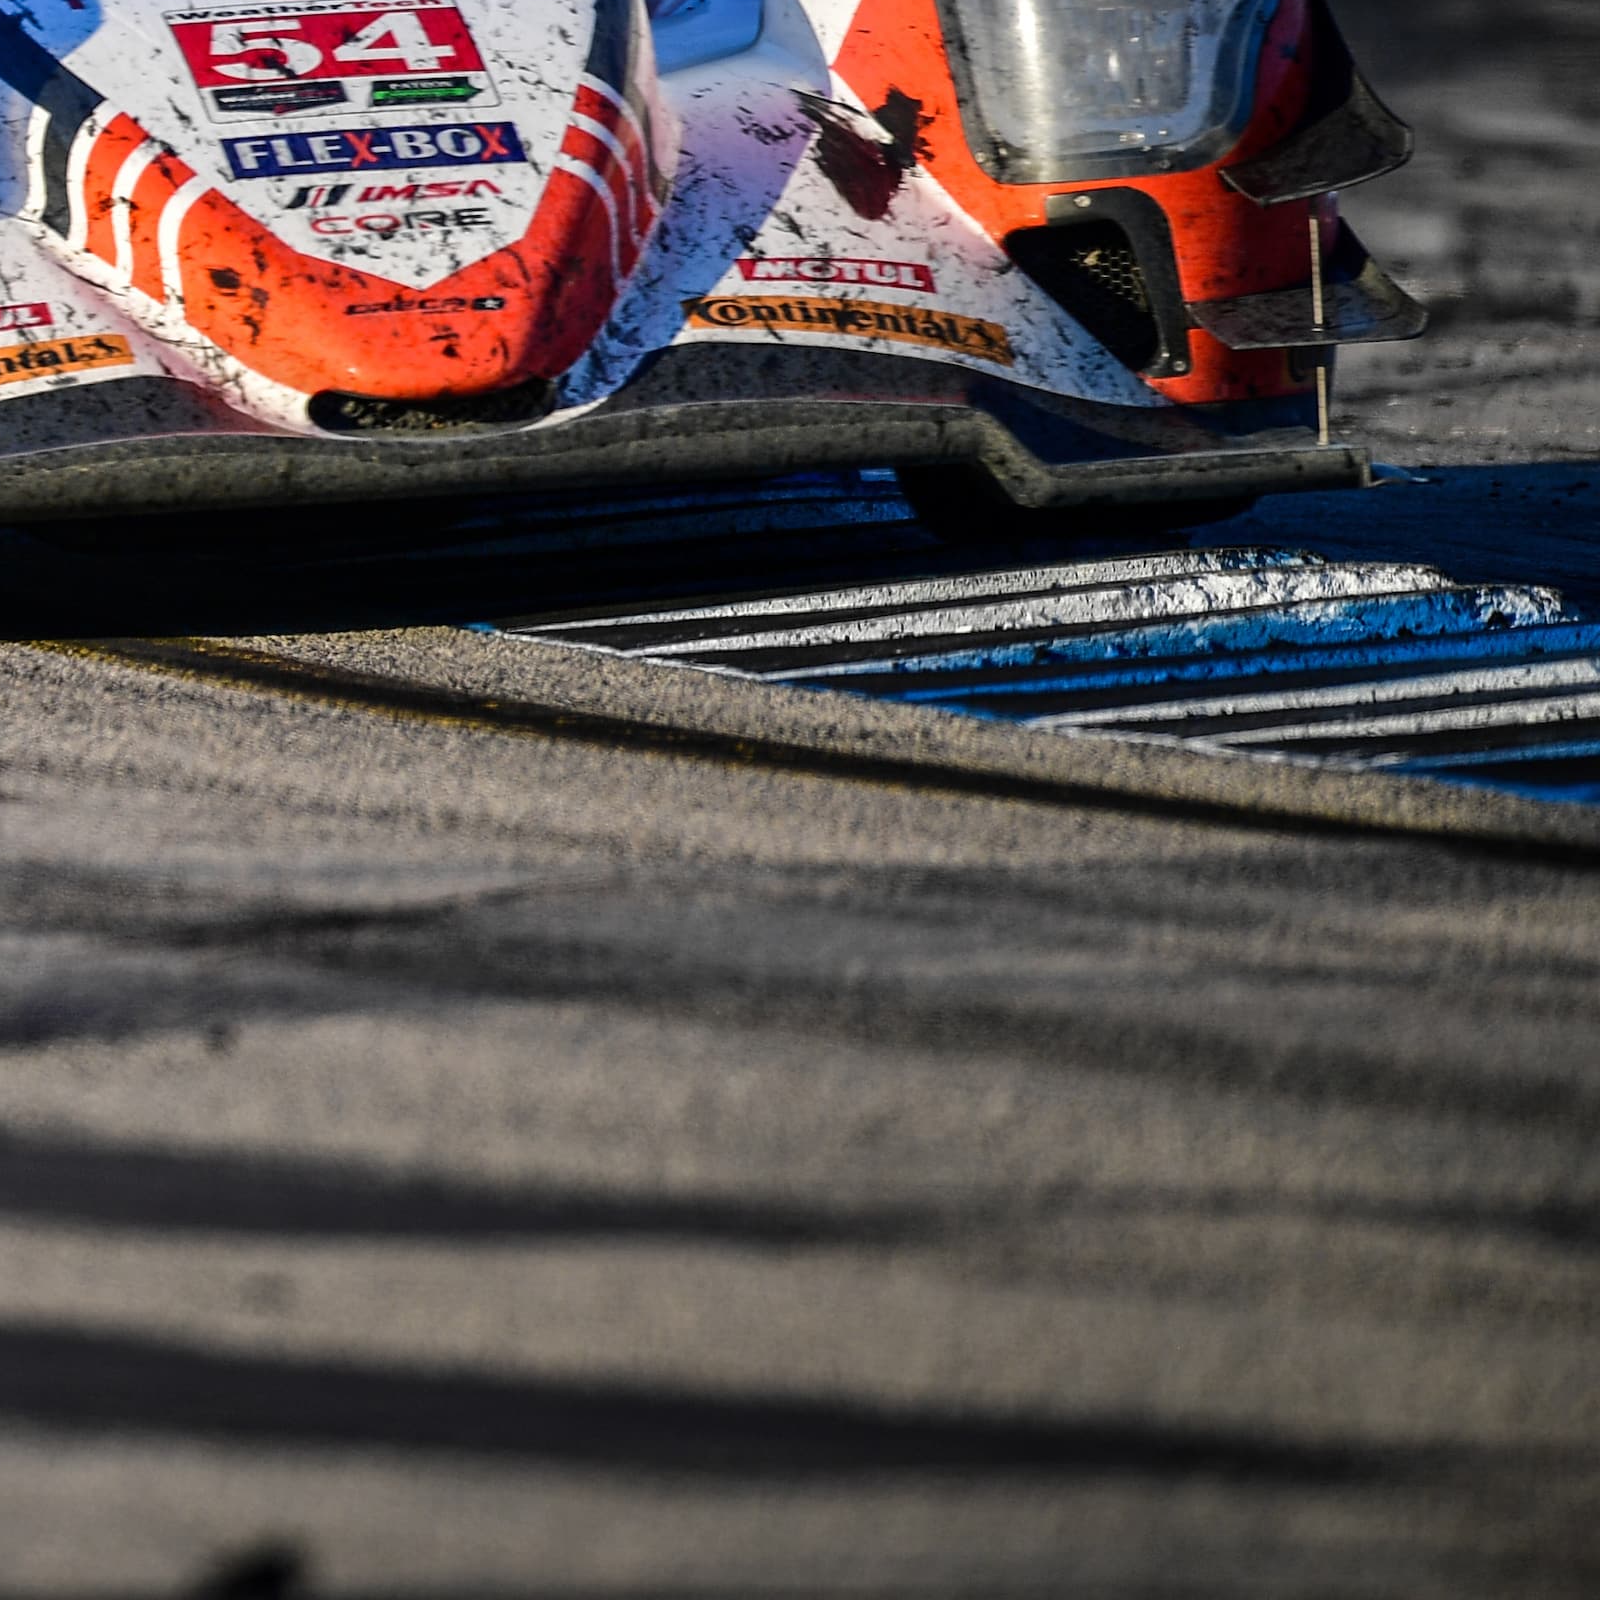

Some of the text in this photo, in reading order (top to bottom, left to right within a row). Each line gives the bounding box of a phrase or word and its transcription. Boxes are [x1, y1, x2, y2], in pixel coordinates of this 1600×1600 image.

[209, 11, 456, 80] 54
[233, 124, 510, 169] FLEX-BOX
[356, 180, 502, 204] IMSA
[310, 207, 494, 235] CORE
[753, 260, 926, 288] MOTUL
[699, 299, 964, 345] Continental
